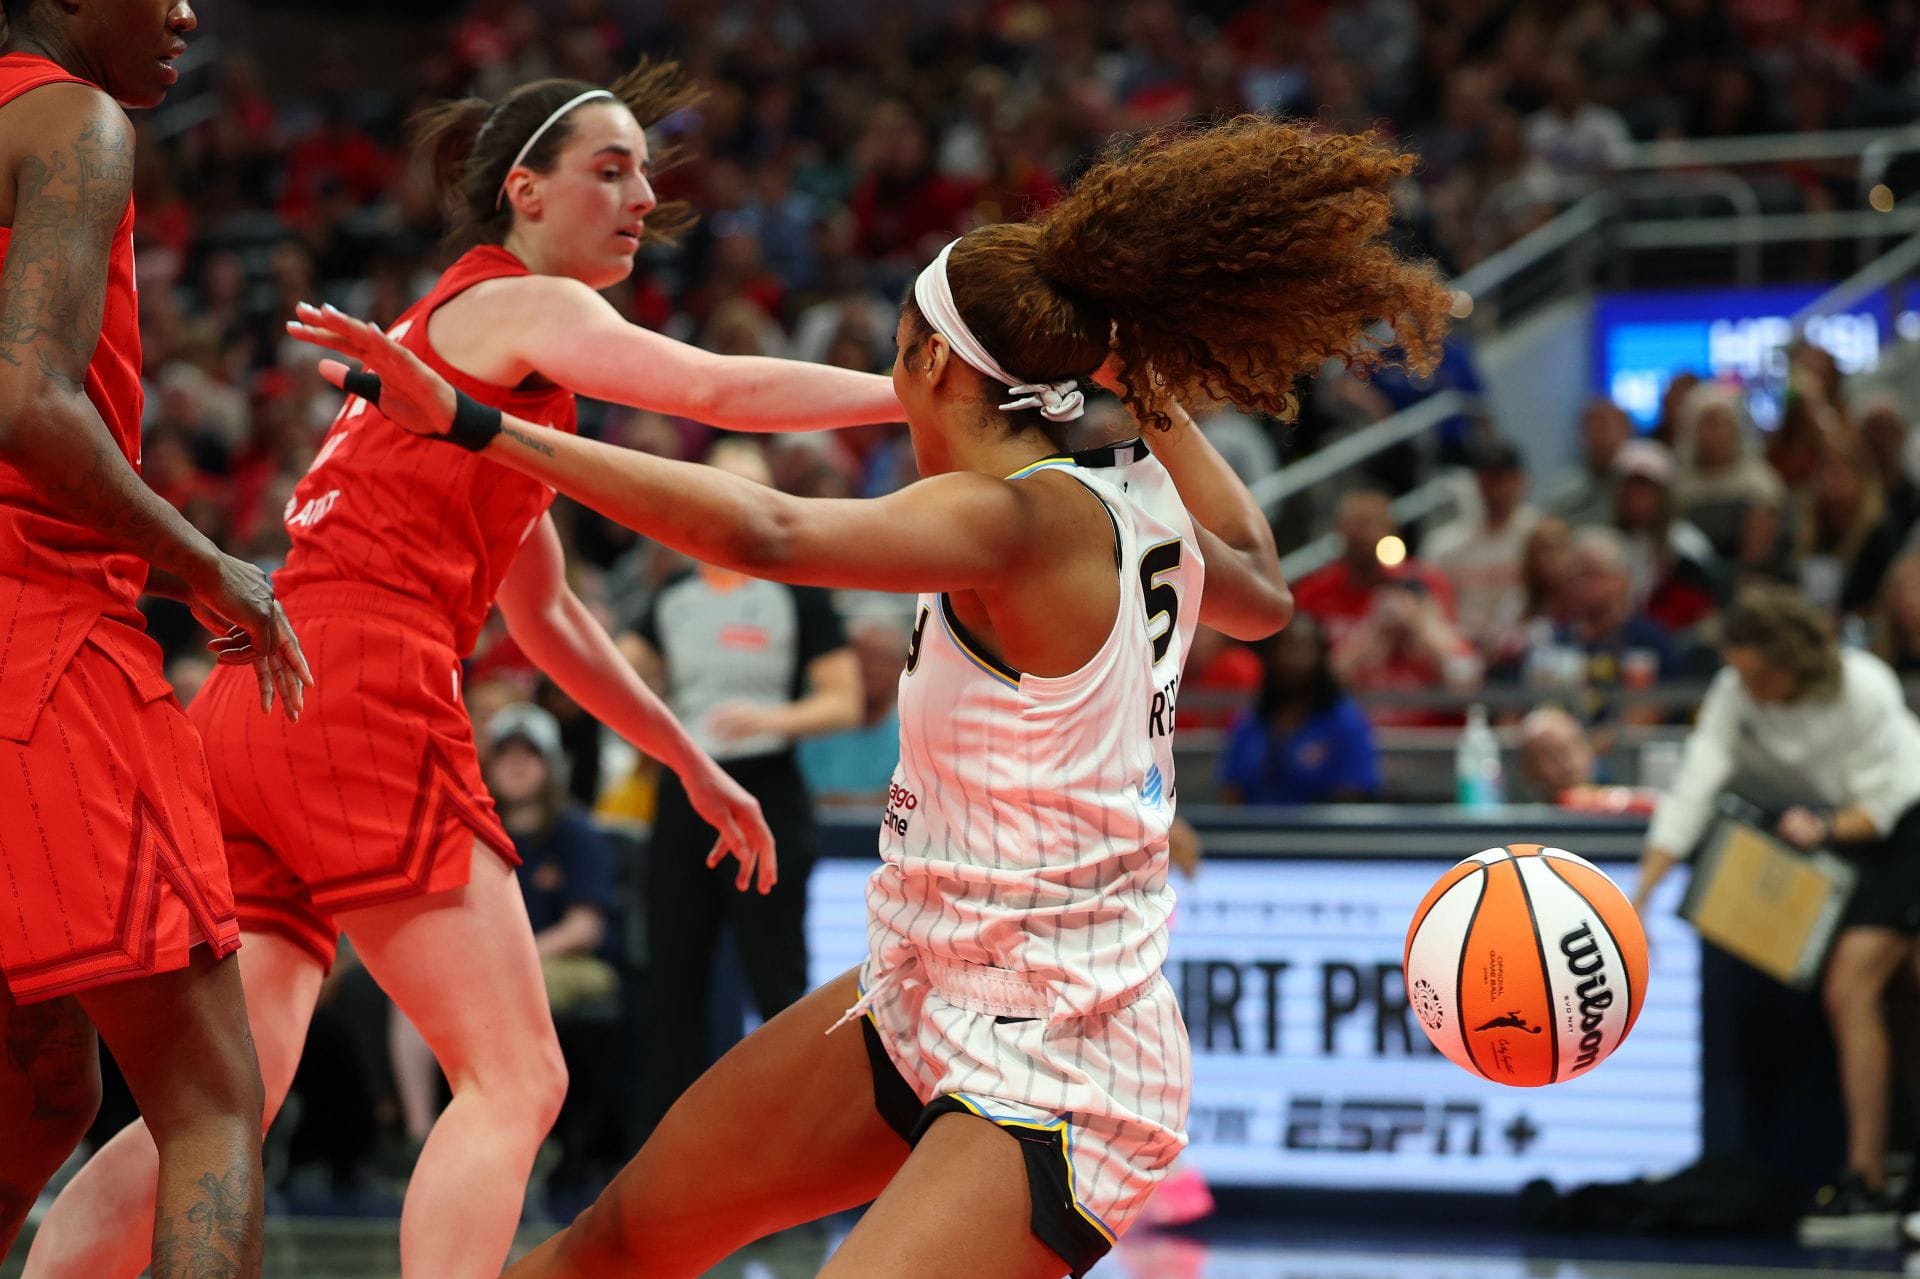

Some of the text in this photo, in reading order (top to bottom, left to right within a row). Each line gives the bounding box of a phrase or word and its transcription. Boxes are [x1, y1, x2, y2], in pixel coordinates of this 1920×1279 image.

[1138, 536, 1184, 668] 5
[890, 783, 918, 811] ago
[1560, 919, 1614, 1073] Wilson
